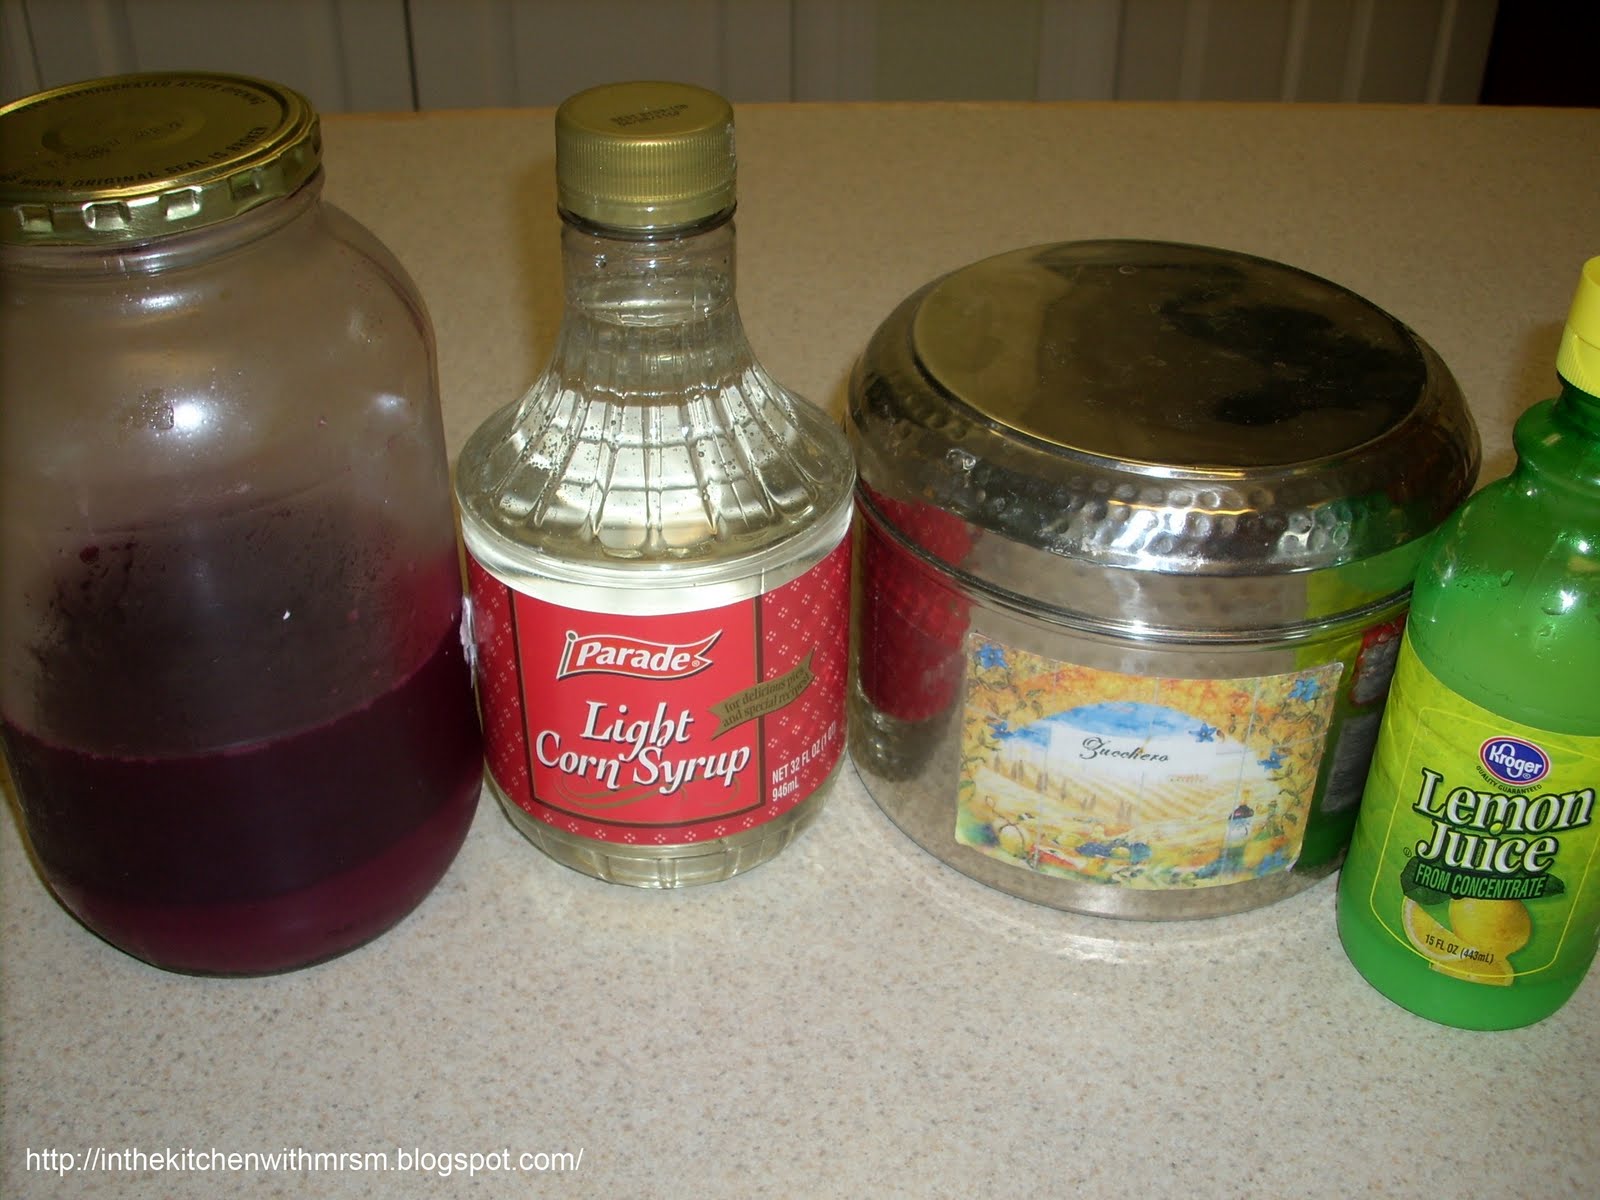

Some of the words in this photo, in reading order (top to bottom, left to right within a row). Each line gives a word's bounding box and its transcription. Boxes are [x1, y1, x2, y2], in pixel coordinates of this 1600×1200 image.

[72, 171, 159, 187] ORIGINAL
[165, 159, 209, 175] SEAL
[208, 151, 229, 160] IS
[576, 641, 691, 672] Parade
[723, 697, 740, 714] for
[742, 679, 785, 705] delicious
[723, 711, 742, 728] and
[744, 696, 776, 719] special
[580, 700, 694, 763] Light
[1080, 736, 1169, 762] Zucchero
[536, 730, 621, 791] Corn
[632, 745, 751, 796] Syrup
[772, 763, 789, 785] NET
[790, 757, 800, 775] 32
[801, 749, 811, 767] FL
[811, 739, 821, 758] OZ
[1489, 743, 1542, 779] Kroger
[772, 775, 800, 802] 946mL
[1476, 765, 1498, 787] QUALITY
[1497, 783, 1543, 795] GUARANTEED
[1413, 768, 1595, 835] Lemon
[1416, 820, 1559, 874] Juice
[1414, 863, 1451, 891] FROM
[1451, 874, 1547, 898] CONCENTRATE
[1424, 933, 1435, 946] 15
[1435, 937, 1446, 950] FL
[1446, 942, 1459, 956] OZ
[1459, 948, 1494, 965] (443mL)
